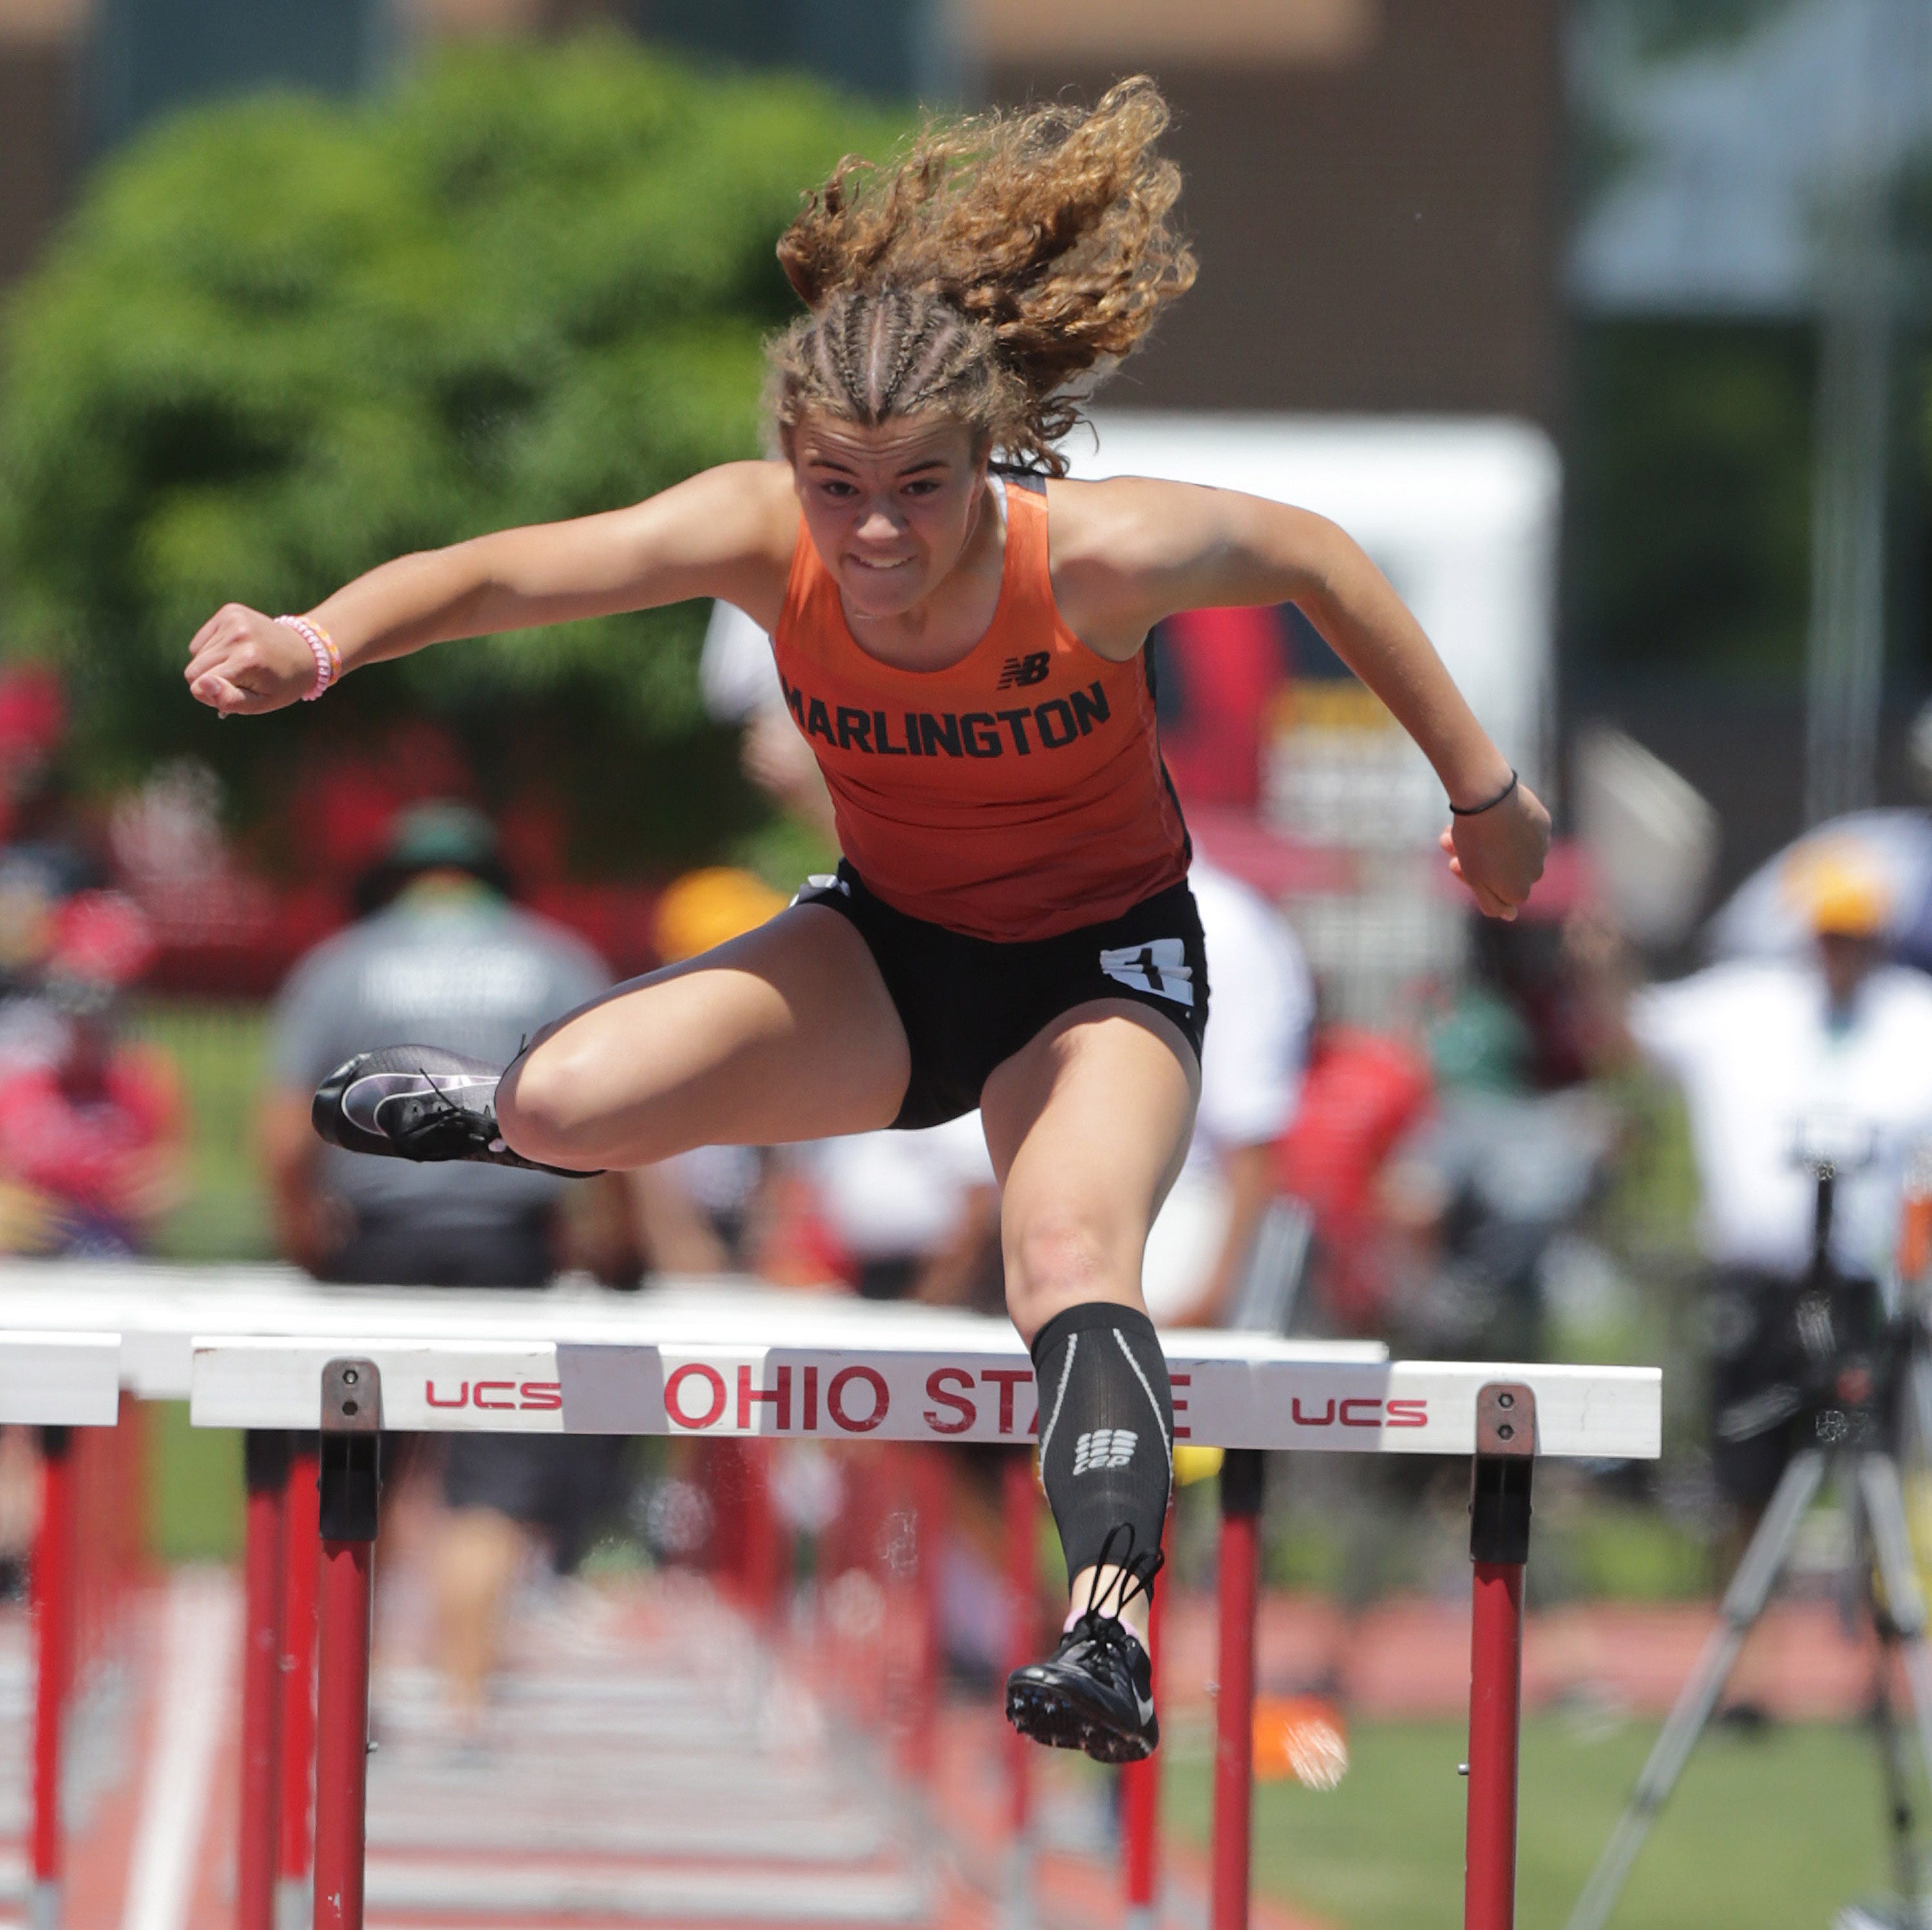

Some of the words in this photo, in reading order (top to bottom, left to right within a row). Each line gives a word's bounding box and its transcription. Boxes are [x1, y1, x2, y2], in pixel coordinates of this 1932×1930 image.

[996, 651, 1050, 690] NB
[781, 672, 1112, 759] MARLINGTON
[426, 1380, 562, 1410] UCS
[663, 1363, 890, 1432] OHIO
[1292, 1399, 1428, 1427] UCS
